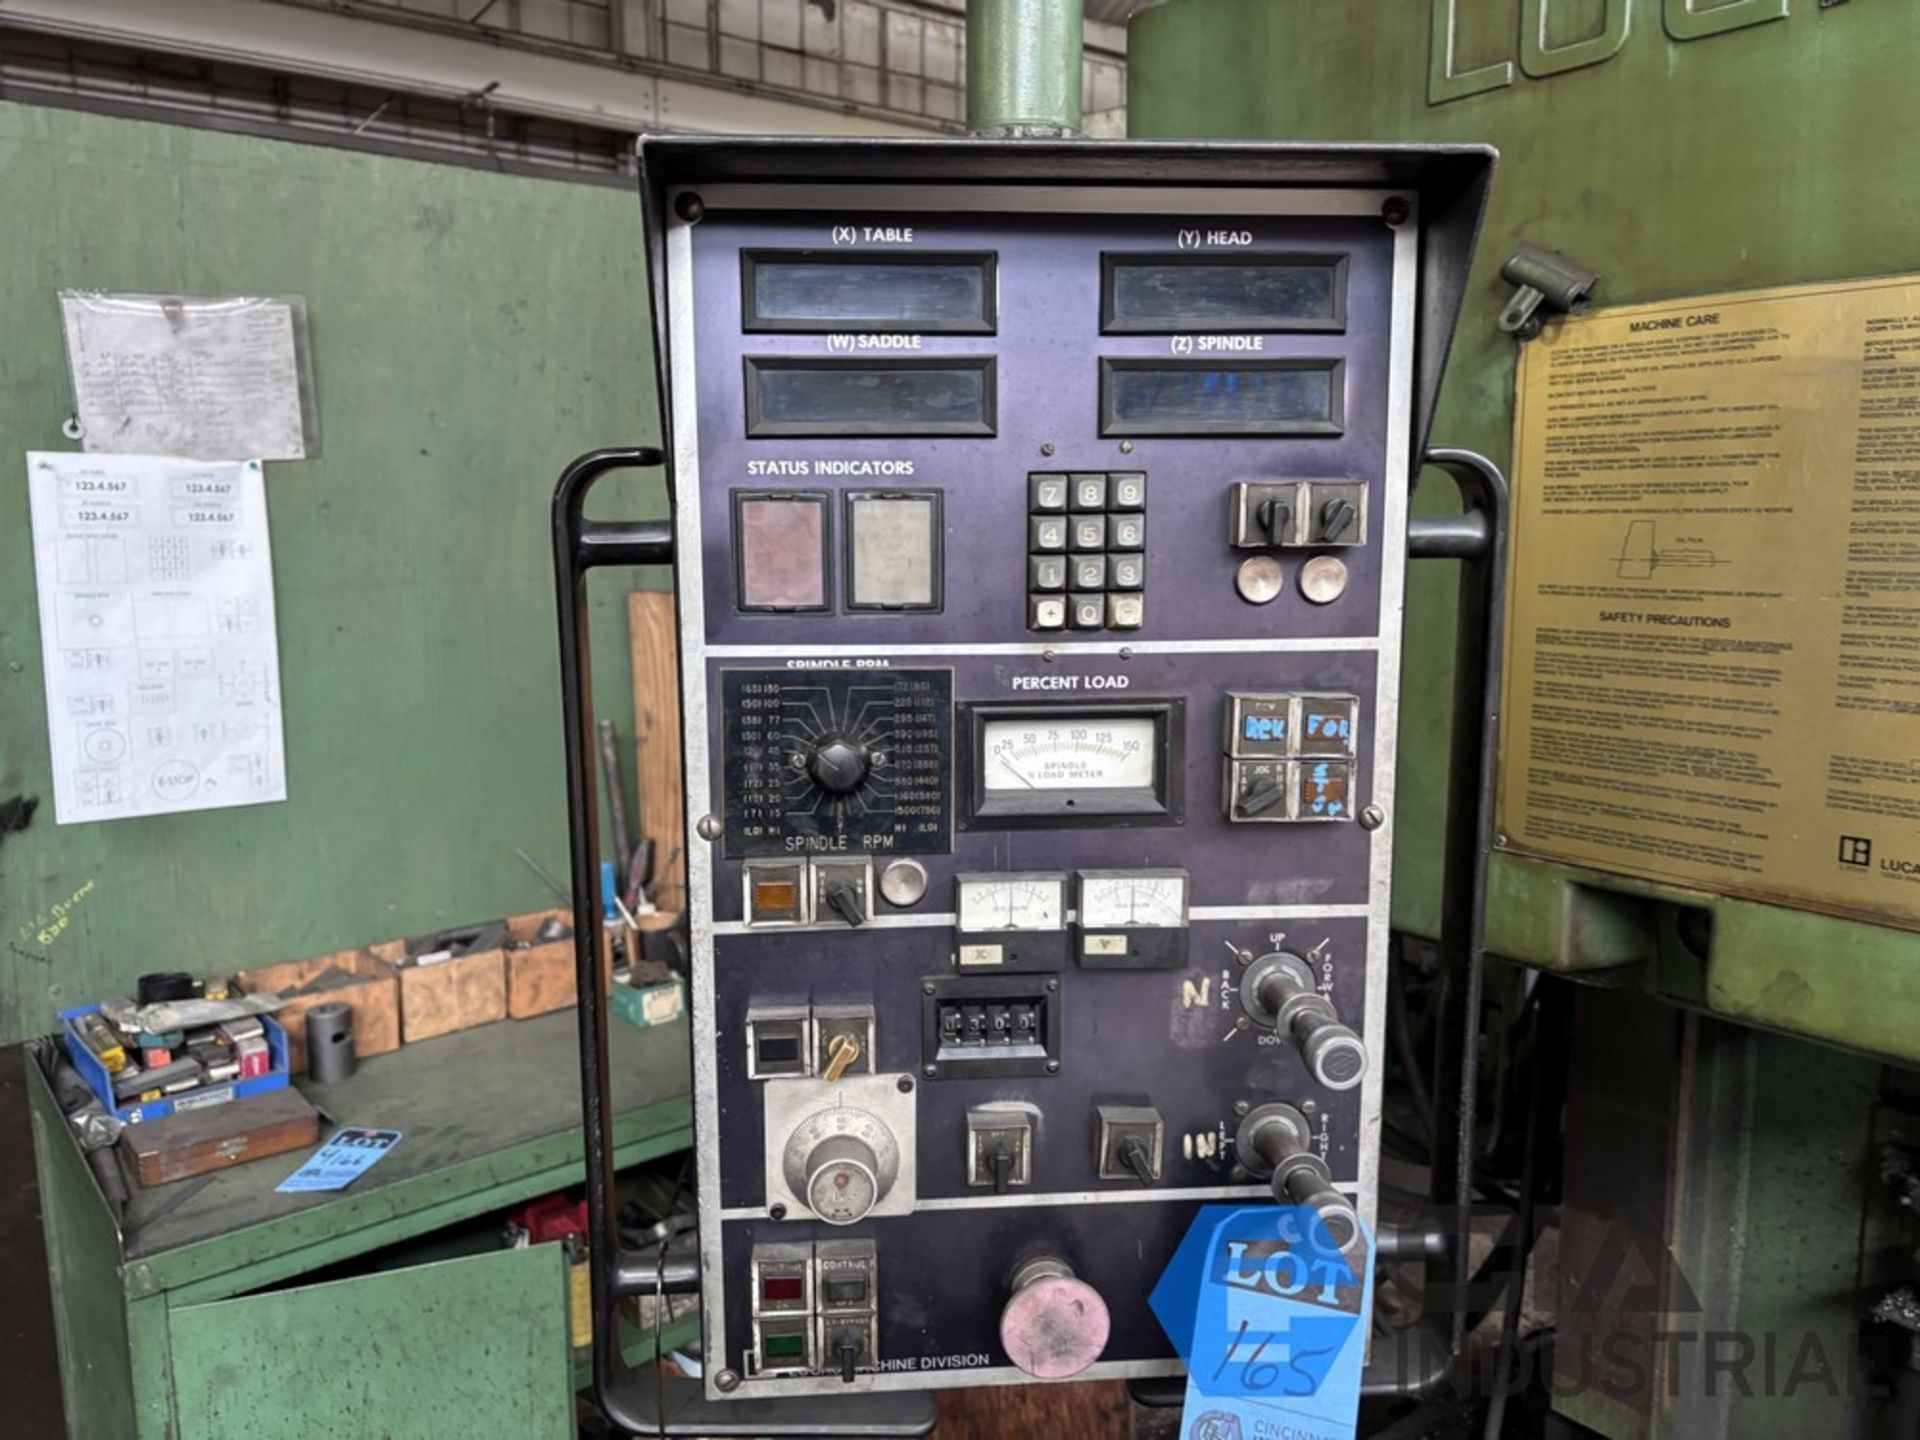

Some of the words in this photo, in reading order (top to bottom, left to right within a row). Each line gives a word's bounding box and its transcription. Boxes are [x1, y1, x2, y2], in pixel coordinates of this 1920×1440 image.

[832, 227, 857, 245] (X)
[863, 228, 913, 242] TABLE
[1178, 230, 1201, 248] (Y)
[1207, 231, 1252, 245] HEAD
[1629, 316, 1682, 332] MACHINE
[1686, 312, 1720, 327] CARE
[827, 335, 855, 352] (W)
[858, 335, 922, 349] SADDLE
[1170, 335, 1193, 354] (Z)
[1198, 336, 1263, 350] SPINDLE
[747, 460, 810, 475] STATUS
[814, 460, 914, 475] INDICATORS
[1043, 487, 1057, 502] 7
[1084, 485, 1097, 499] 8
[1124, 485, 1137, 500] 9
[1044, 527, 1057, 541] 4
[1083, 527, 1095, 541] 5
[1123, 526, 1135, 540] 6
[1048, 568, 1055, 582] 1
[1084, 567, 1096, 580] 2
[1122, 566, 1134, 580] 3
[1082, 605, 1096, 620] 0
[1599, 611, 1643, 623] SAFETY
[1647, 614, 1731, 629] PRECAUTIONS
[1013, 676, 1079, 690] PERCENT
[1085, 675, 1129, 689] LOAD
[1001, 739, 1014, 751] 25
[1023, 733, 1037, 744] 50
[1048, 730, 1059, 740] 75
[1071, 729, 1087, 740] 100
[1096, 732, 1112, 743] 125
[1123, 740, 1140, 751] 150
[1038, 771, 1064, 779] LOAD
[1069, 770, 1103, 778] METER
[1044, 762, 1087, 770] SPINDLE
[785, 835, 848, 850] SPINDLE
[863, 835, 894, 849] RPM
[1270, 932, 1286, 943] UP
[1322, 953, 1333, 1001] FORWA
[1221, 970, 1231, 1010] BACK
[994, 1017, 1005, 1030] 0
[336, 1136, 389, 1148] LOT
[1223, 1242, 1360, 1305] LOT
[921, 1354, 990, 1368] DIVISION
[1212, 1319, 1335, 1397] 165
[1254, 1420, 1335, 1440] CINCINN
